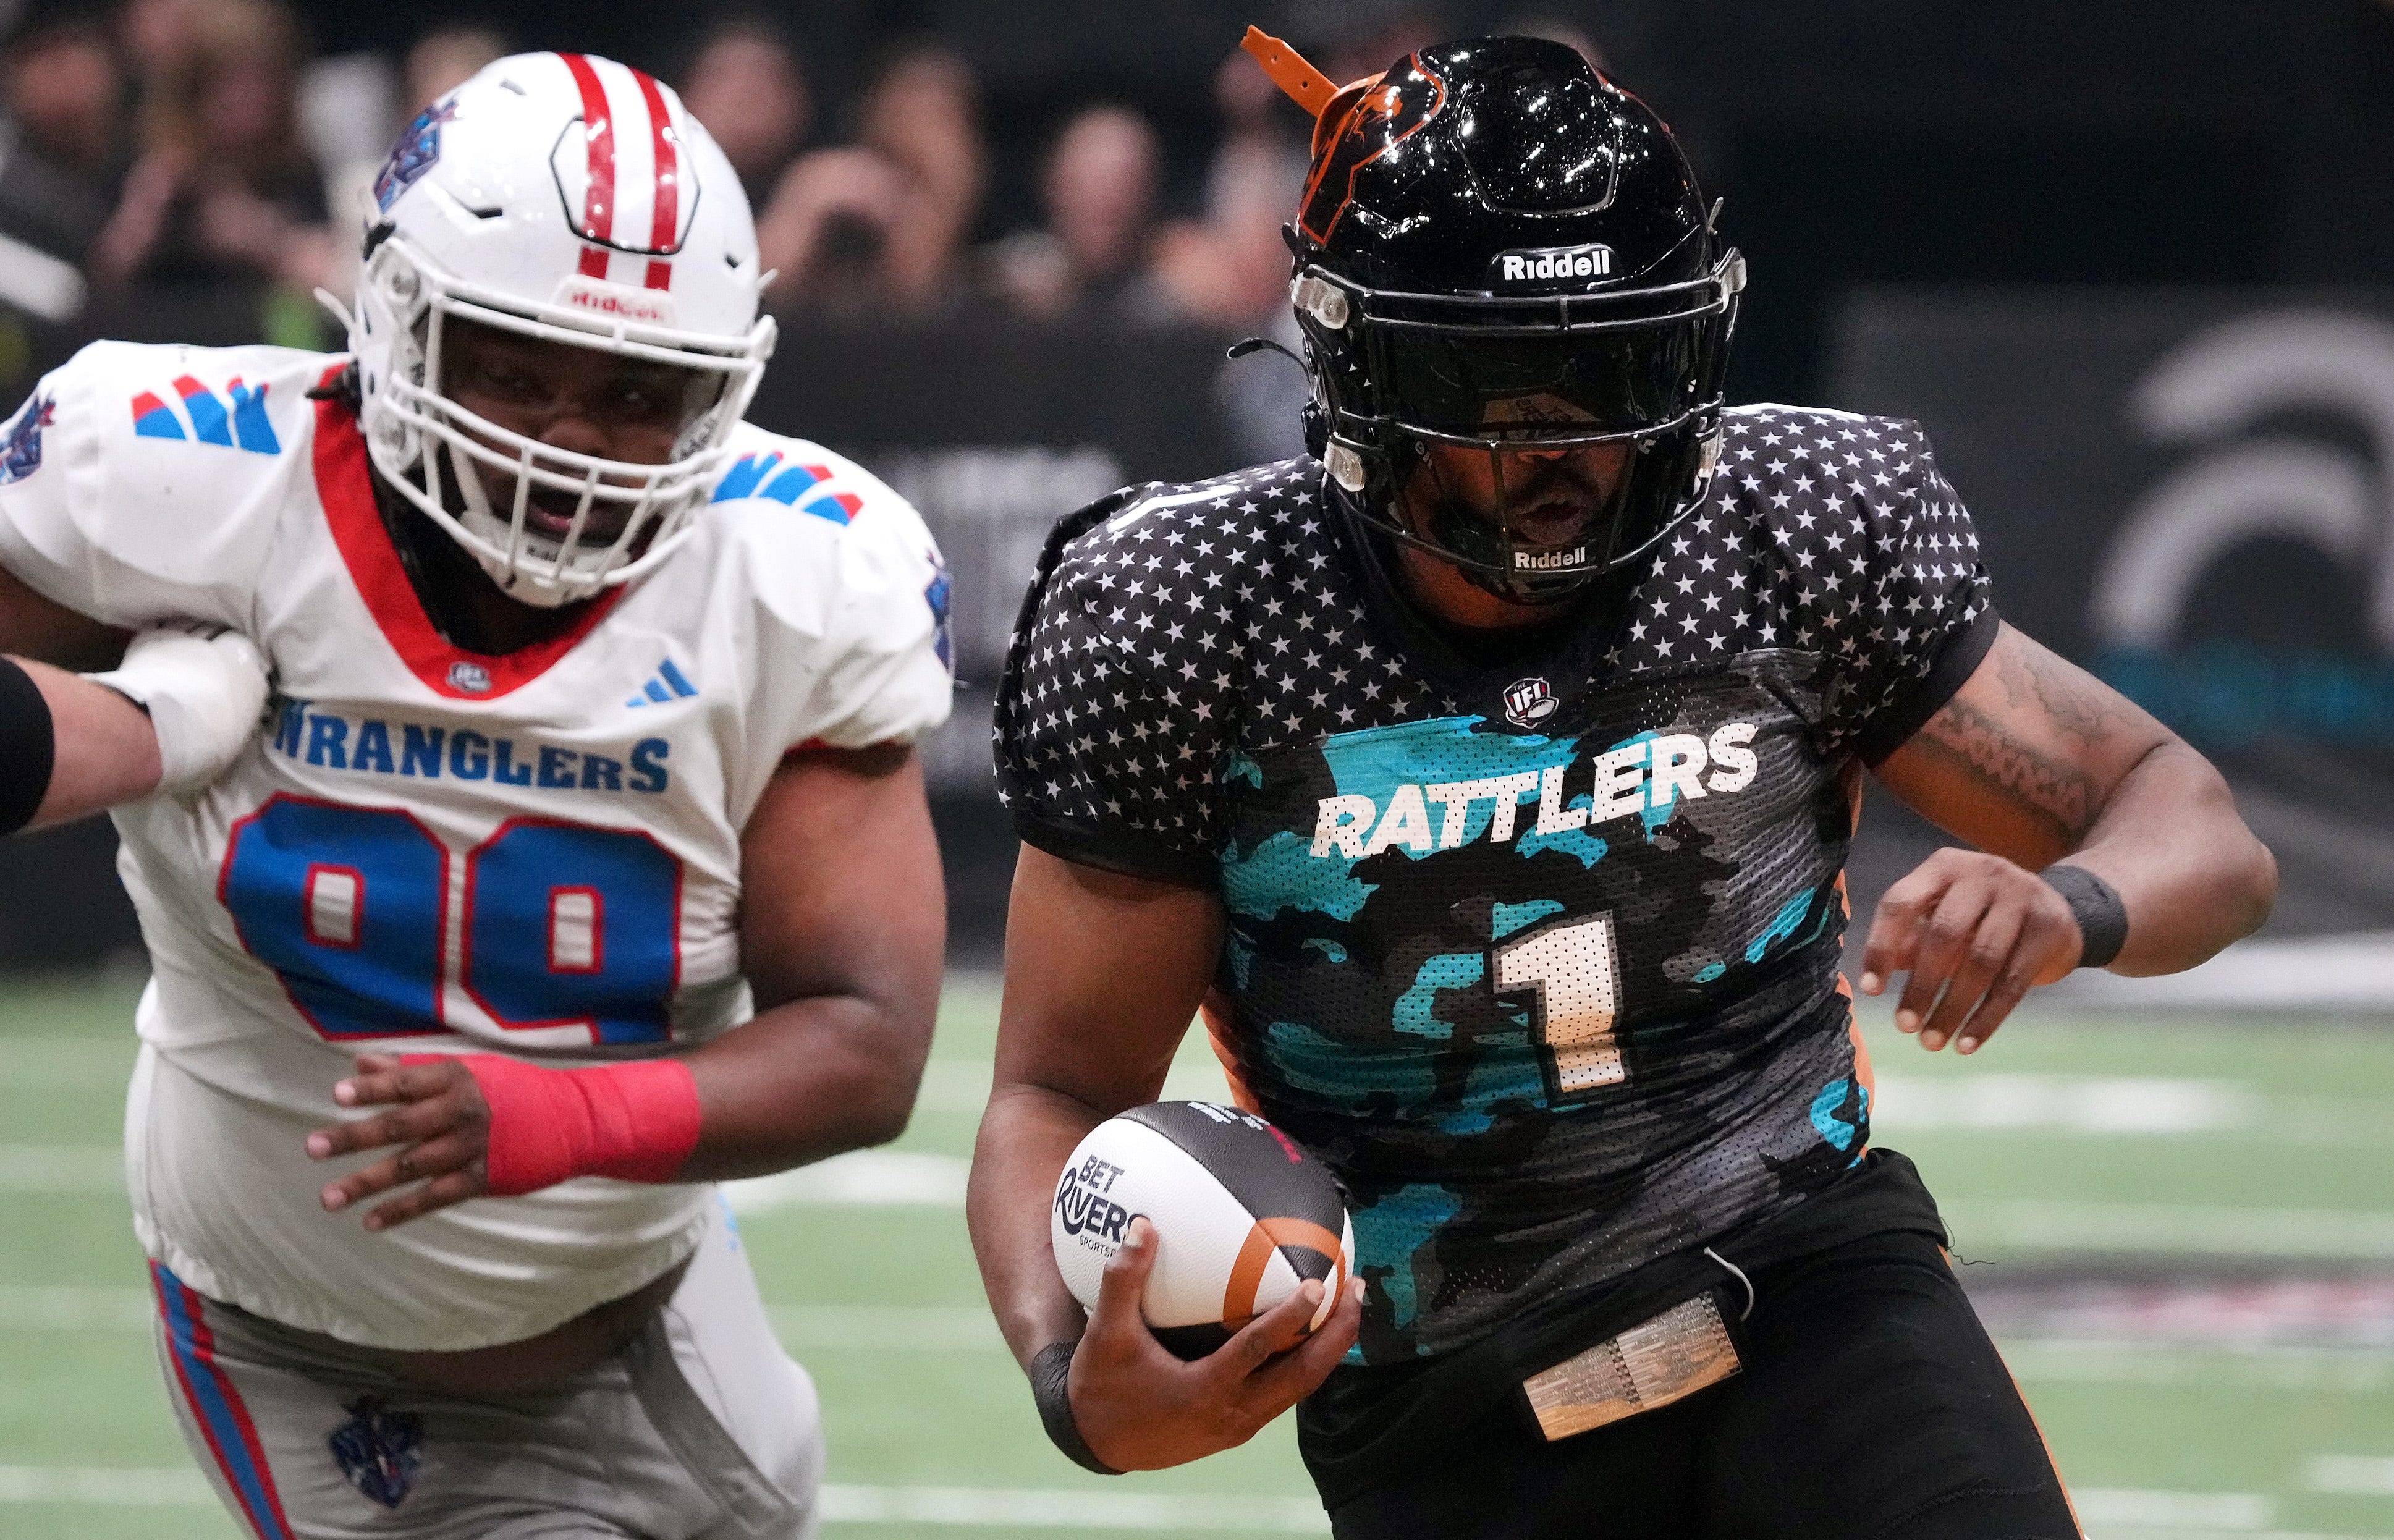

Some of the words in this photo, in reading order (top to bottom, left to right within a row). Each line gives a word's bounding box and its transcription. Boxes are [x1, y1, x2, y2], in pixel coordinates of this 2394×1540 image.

[1503, 250, 1610, 280] Riddell
[1515, 546, 1586, 569] Riddell
[274, 700, 670, 793] WRANGLERS
[1309, 722, 1760, 859] RATTLERS
[216, 790, 683, 1045] 99
[1493, 910, 1628, 1098] 1
[1078, 1154, 1125, 1193] BET
